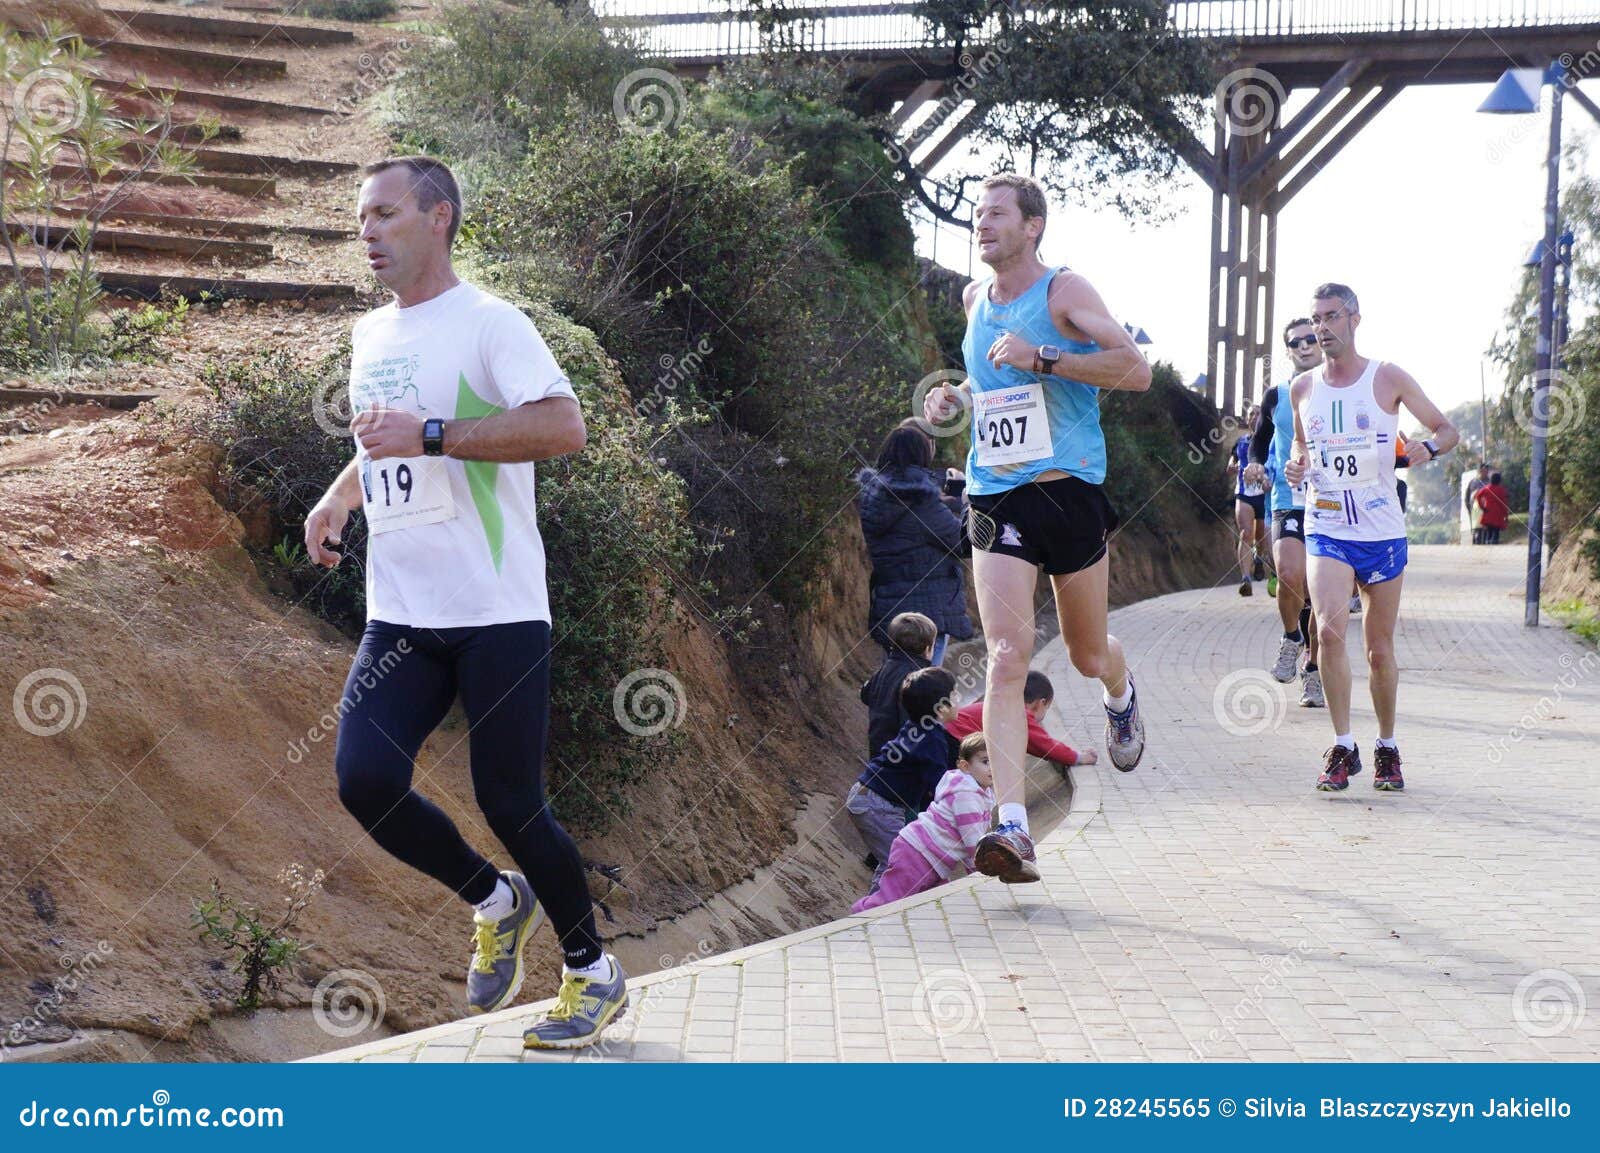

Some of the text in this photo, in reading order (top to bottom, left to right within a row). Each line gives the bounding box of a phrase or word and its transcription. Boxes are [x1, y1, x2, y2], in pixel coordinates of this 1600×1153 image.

[988, 415, 1028, 448] 207
[1334, 454, 1358, 478] 98
[380, 463, 413, 507] 19
